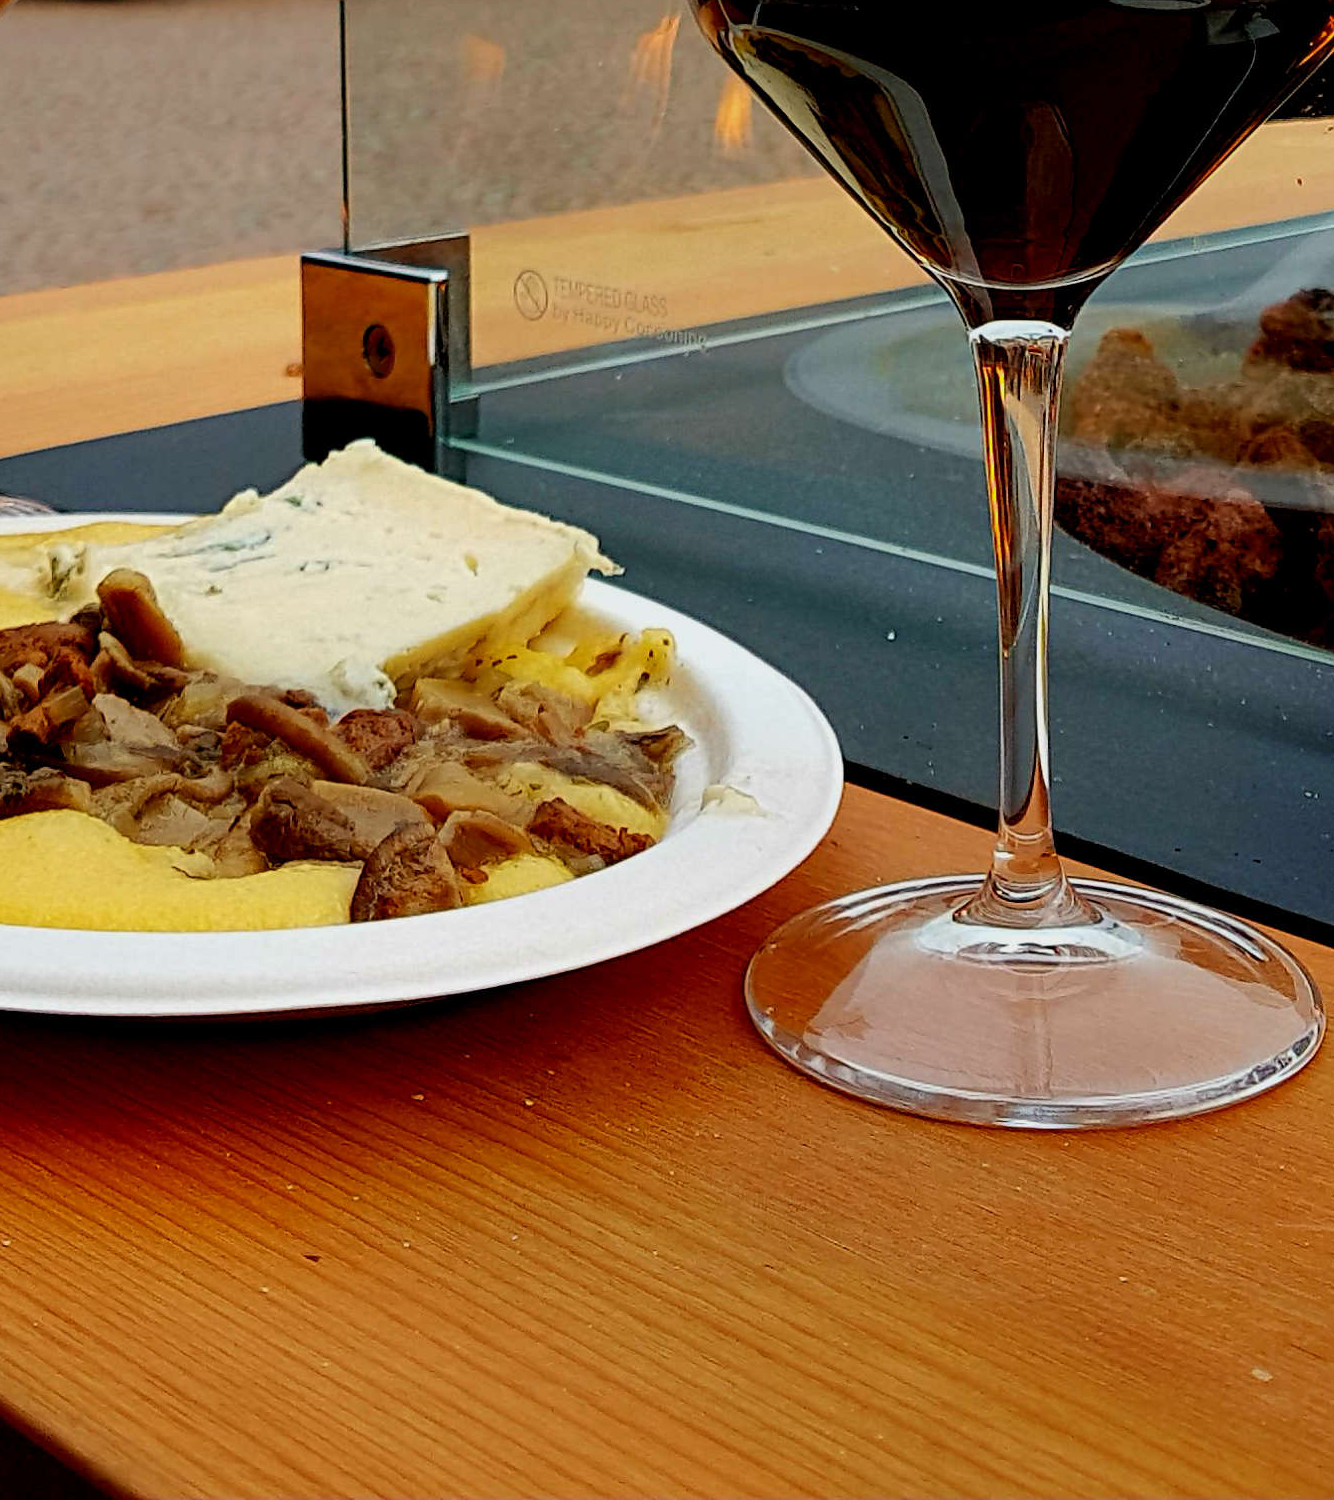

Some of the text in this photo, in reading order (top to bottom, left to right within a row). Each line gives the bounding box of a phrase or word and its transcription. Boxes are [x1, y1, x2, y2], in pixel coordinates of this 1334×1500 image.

[553, 275, 668, 318] TEMPERED GLASS
[573, 306, 620, 334] Happy
